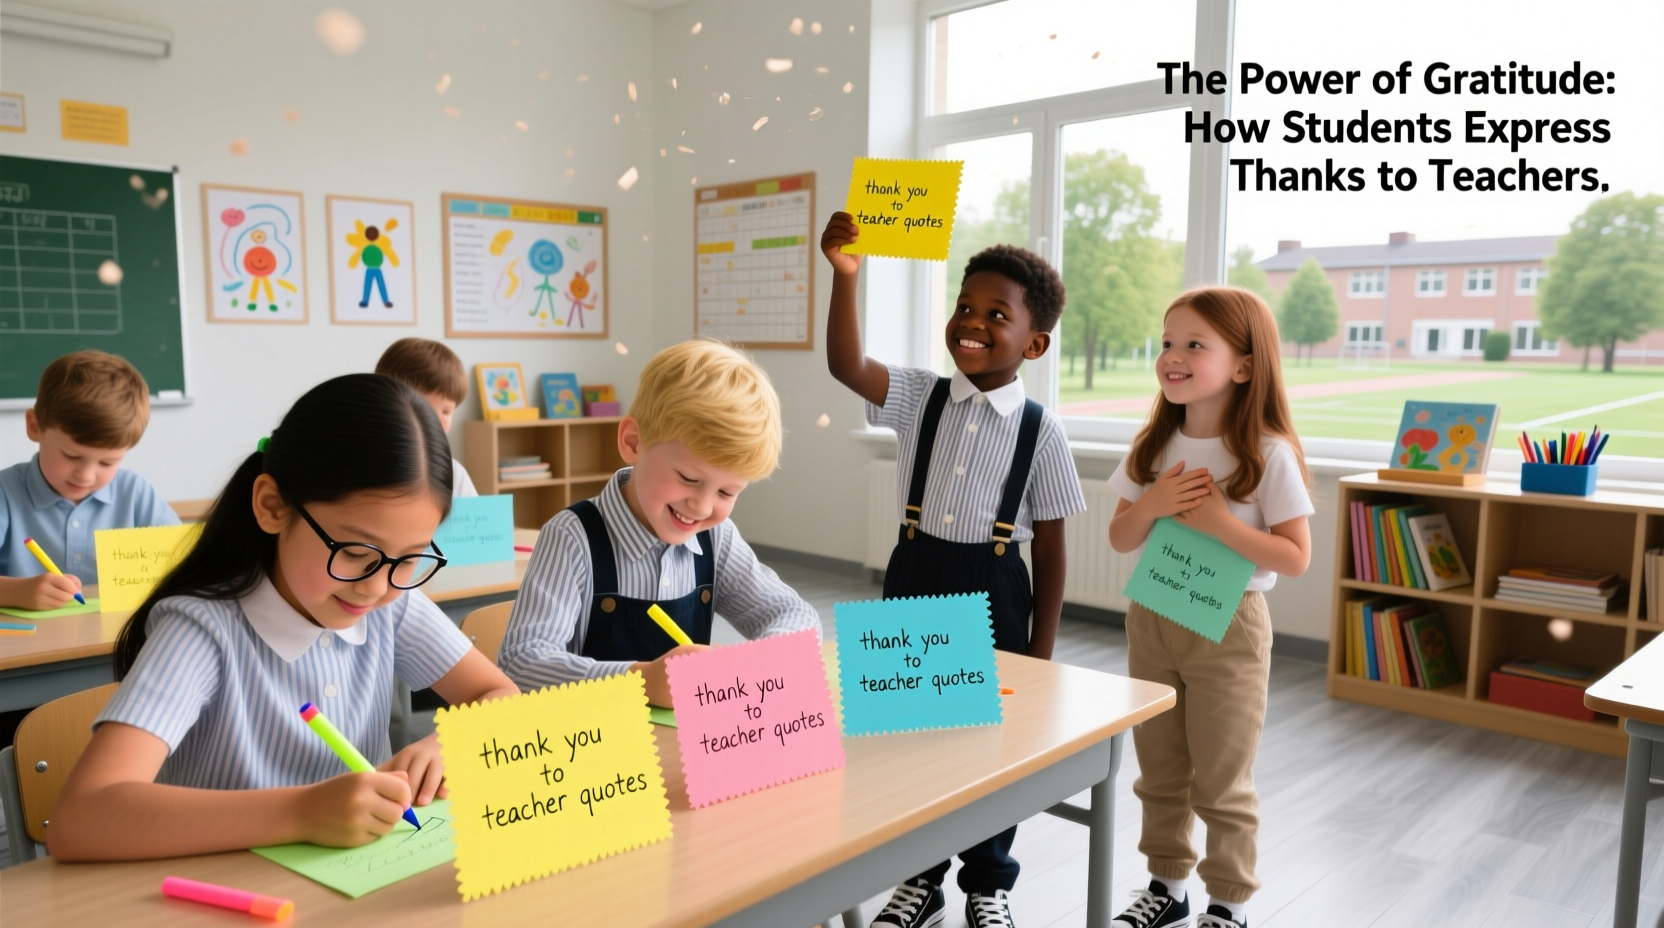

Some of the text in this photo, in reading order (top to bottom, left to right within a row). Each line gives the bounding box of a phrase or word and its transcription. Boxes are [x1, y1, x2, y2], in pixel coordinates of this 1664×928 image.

[865, 179, 928, 202] thank you
[891, 200, 903, 211] to
[904, 214, 943, 233] quotes
[859, 628, 949, 655] thank you
[903, 653, 921, 668] to
[695, 676, 784, 706] thank you
[859, 668, 985, 695] teacher quotes
[744, 704, 762, 720] to
[700, 711, 825, 754] teacher quotes
[479, 728, 602, 769] thank you
[540, 764, 564, 785] to
[482, 773, 647, 830] teacher quotes
